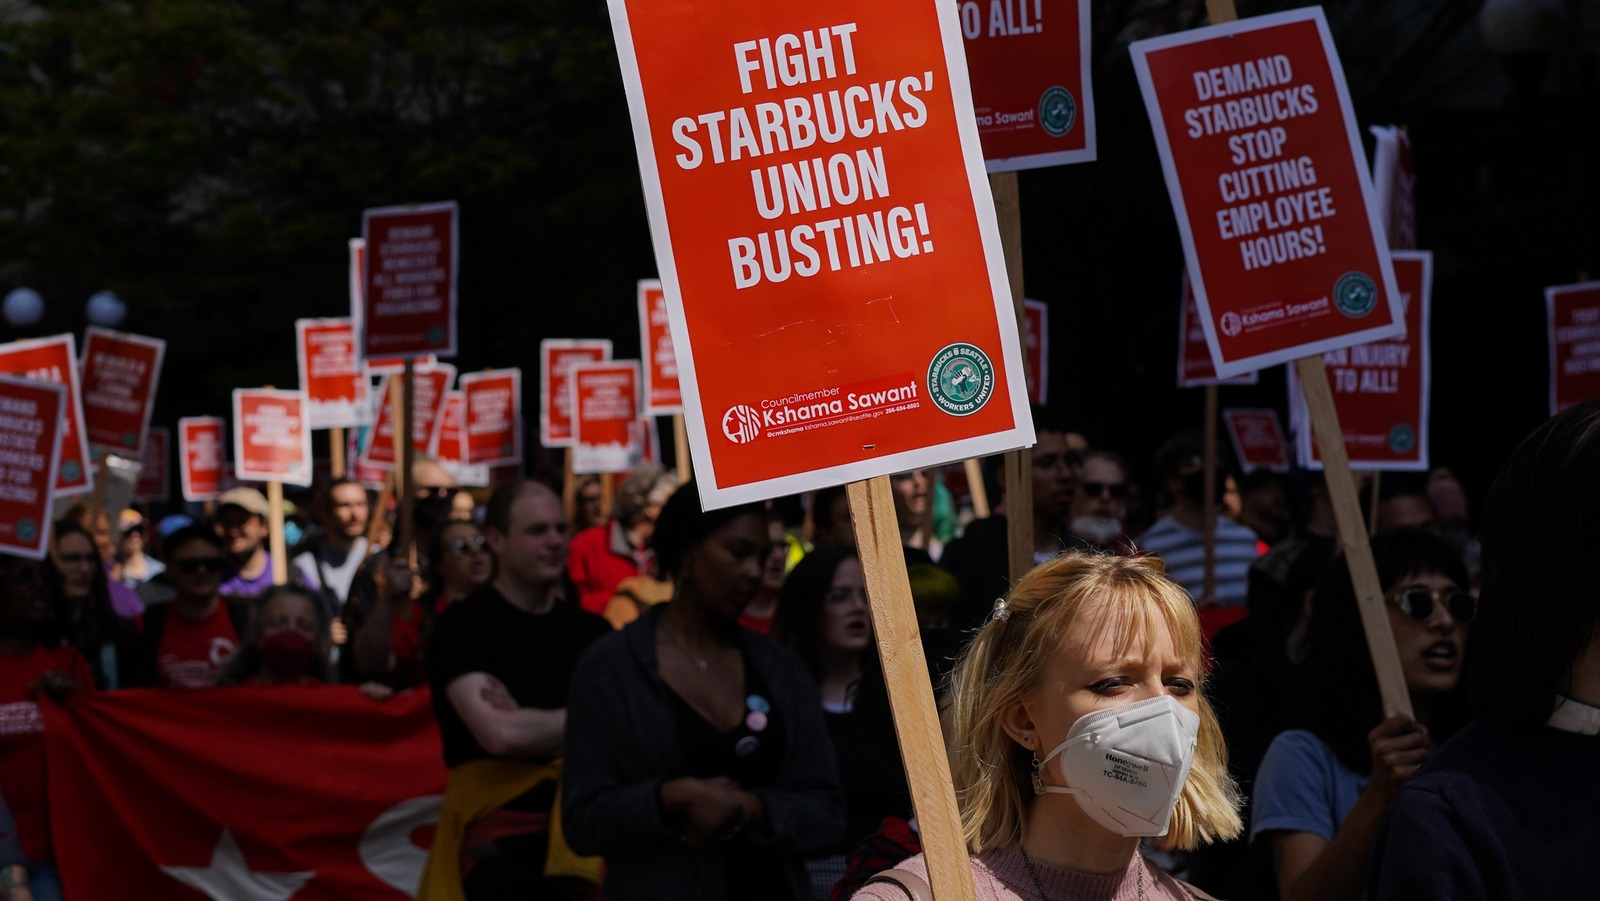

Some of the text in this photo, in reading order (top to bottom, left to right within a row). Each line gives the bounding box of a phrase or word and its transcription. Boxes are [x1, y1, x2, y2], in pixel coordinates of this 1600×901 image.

[958, 0, 1043, 39] O ALL!
[733, 23, 858, 94] FIGHT
[1193, 54, 1293, 101] DEMAND
[671, 71, 934, 170] STARBUCKS'
[995, 109, 1034, 125] Sawant
[1184, 84, 1319, 139] STARBUCKS
[1228, 126, 1287, 165] STOP
[750, 147, 891, 220] UNION
[1218, 156, 1316, 203] CUTTING
[1216, 187, 1336, 240] EMPLOYEE
[727, 202, 934, 289] BUSTING!
[1240, 225, 1326, 270] HOURS!
[1242, 308, 1285, 326] Kshama
[1286, 296, 1329, 316] Sawant
[931, 348, 988, 393] STARBUCKS SEATTLE
[1351, 344, 1411, 367] INJURY
[760, 386, 840, 409] Councilmember
[937, 374, 990, 411] WORKERS UNITED
[1335, 369, 1398, 393] TO ALL!
[763, 381, 918, 427] Kshama Sawant
[766, 426, 804, 438] @cmkshama
[804, 410, 884, 432] kshama.sawant@seattle.gov
[1105, 753, 1149, 773] Honeywell
